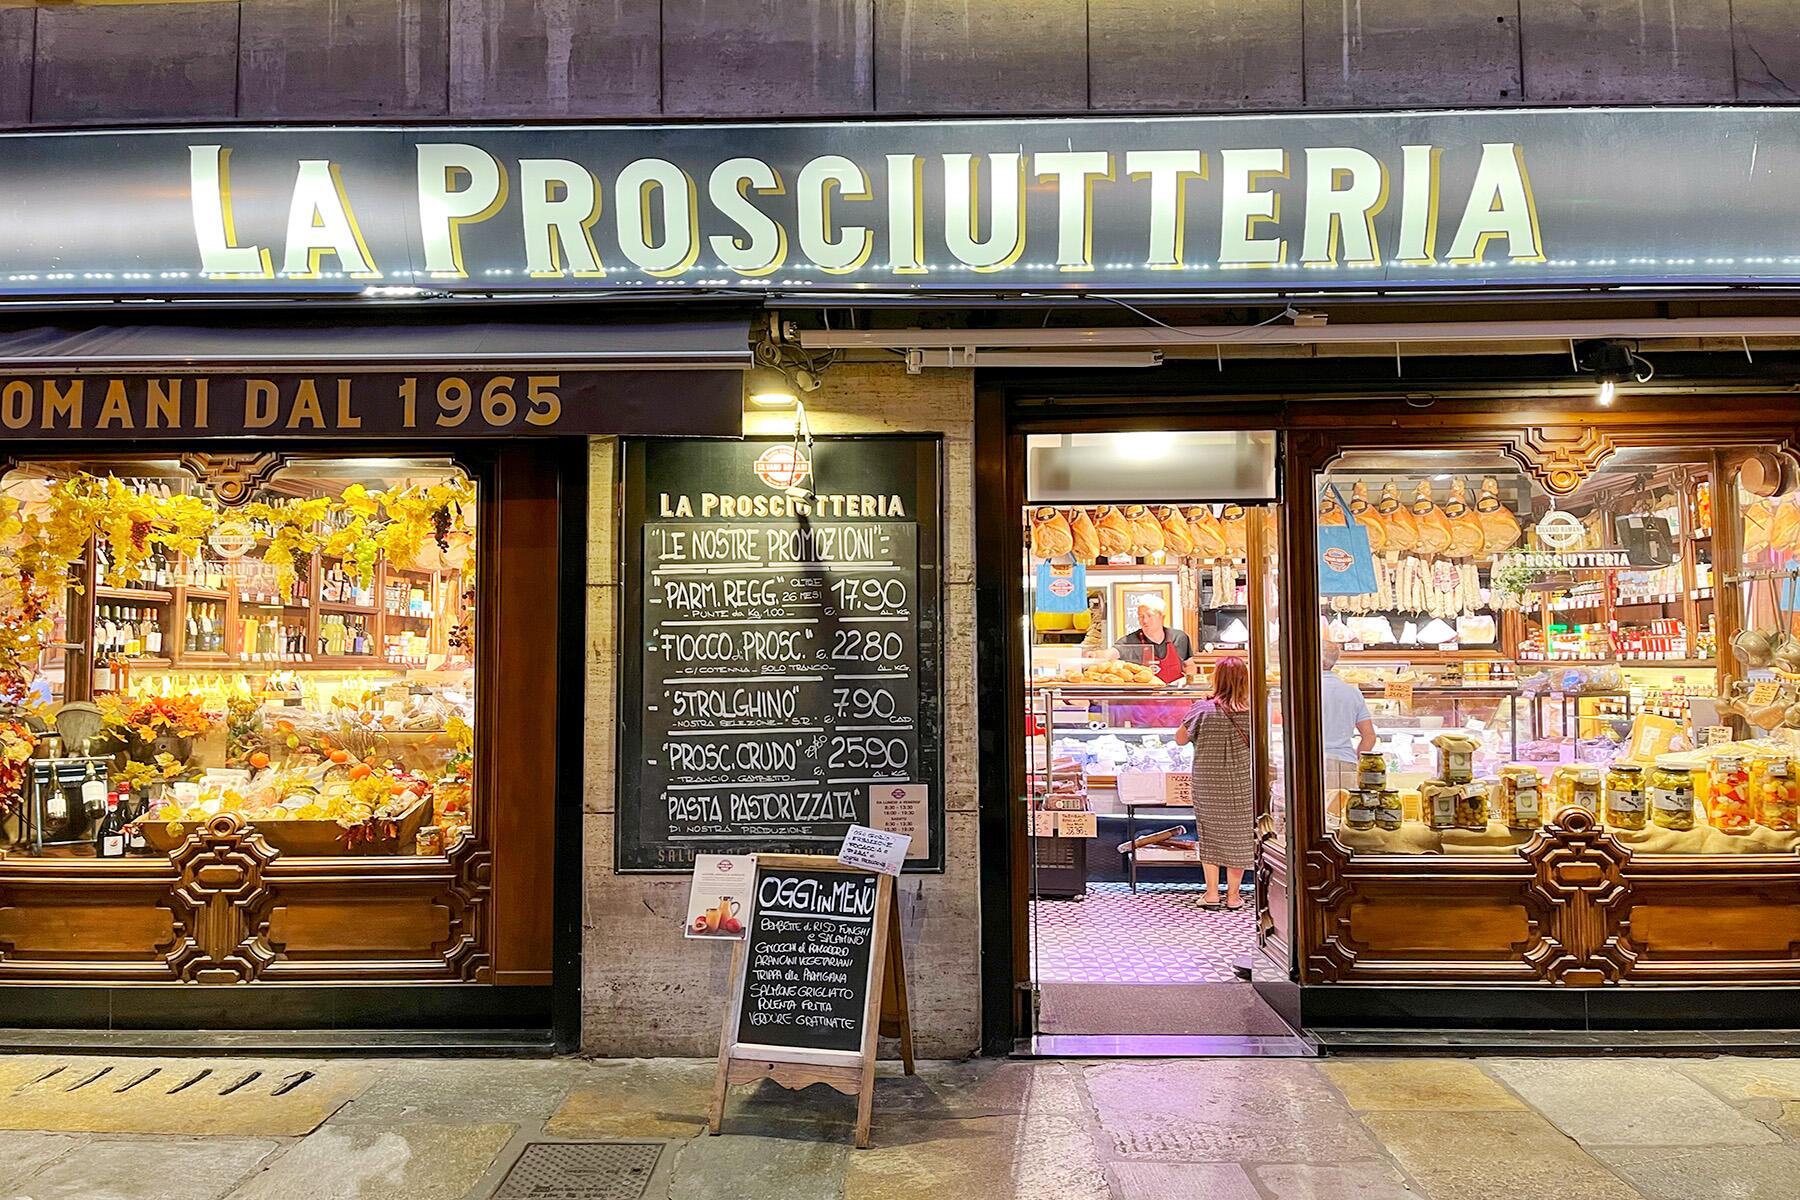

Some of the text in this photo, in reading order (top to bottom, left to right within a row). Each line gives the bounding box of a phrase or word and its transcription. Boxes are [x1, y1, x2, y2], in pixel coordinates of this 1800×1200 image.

[188, 142, 1546, 279] LA PROSCIUTTERIA
[243, 378, 362, 429] DAL
[398, 375, 562, 428] 1965
[660, 493, 693, 517] LA
[692, 527, 761, 561] NOSTRE
[1515, 553, 1631, 567] PROSCIUTTERIA
[782, 590, 822, 602] 26 MESI
[692, 610, 729, 618] PUNTE
[760, 664, 786, 675] SOLO
[677, 719, 715, 728] NOSTRA
[677, 774, 729, 783] TRANCIO
[668, 824, 813, 835] DI NOSTRA PRODUZIONE
[758, 876, 818, 911] OGGI
[813, 922, 836, 933] RISO
[839, 923, 871, 936] FUNGHI
[818, 932, 864, 946] SALAMINO
[754, 941, 797, 954] GNOCCHI
[754, 955, 798, 968] ARANCINI
[752, 969, 783, 981] TRIPPA
[749, 983, 854, 999] SALMONE GRIGLIATO
[758, 997, 833, 1012] POLENTA FRITTA
[748, 1011, 856, 1030] VERDURE GRATINATE
